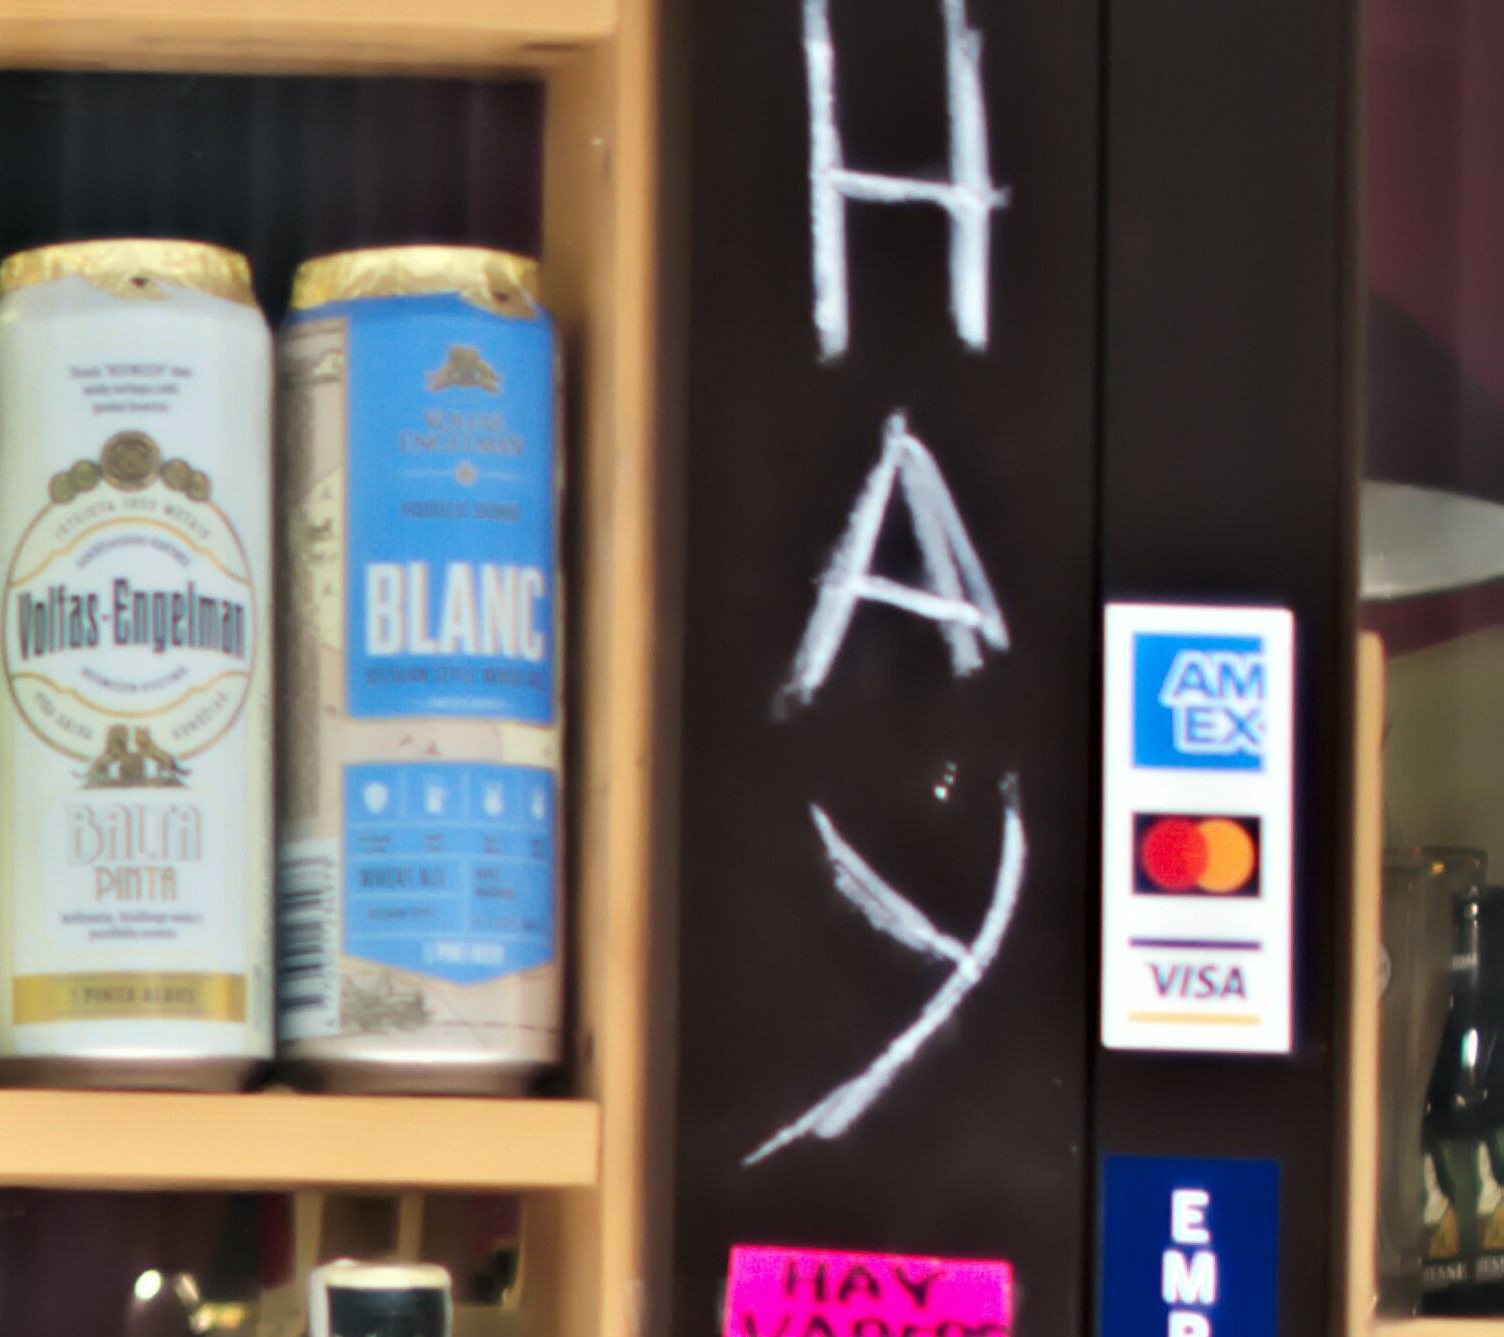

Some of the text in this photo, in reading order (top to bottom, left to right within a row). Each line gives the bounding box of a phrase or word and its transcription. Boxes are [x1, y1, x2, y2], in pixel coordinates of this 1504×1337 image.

[17, 576, 246, 661] Volfas-Engelman
[363, 561, 546, 662] BLANC
[1160, 650, 1265, 706] AM
[1177, 704, 1265, 754] EX
[66, 803, 204, 867] BALTA
[95, 865, 179, 902] PINTA
[1148, 962, 1249, 1000] VISA
[782, 1260, 938, 1309] HAY
